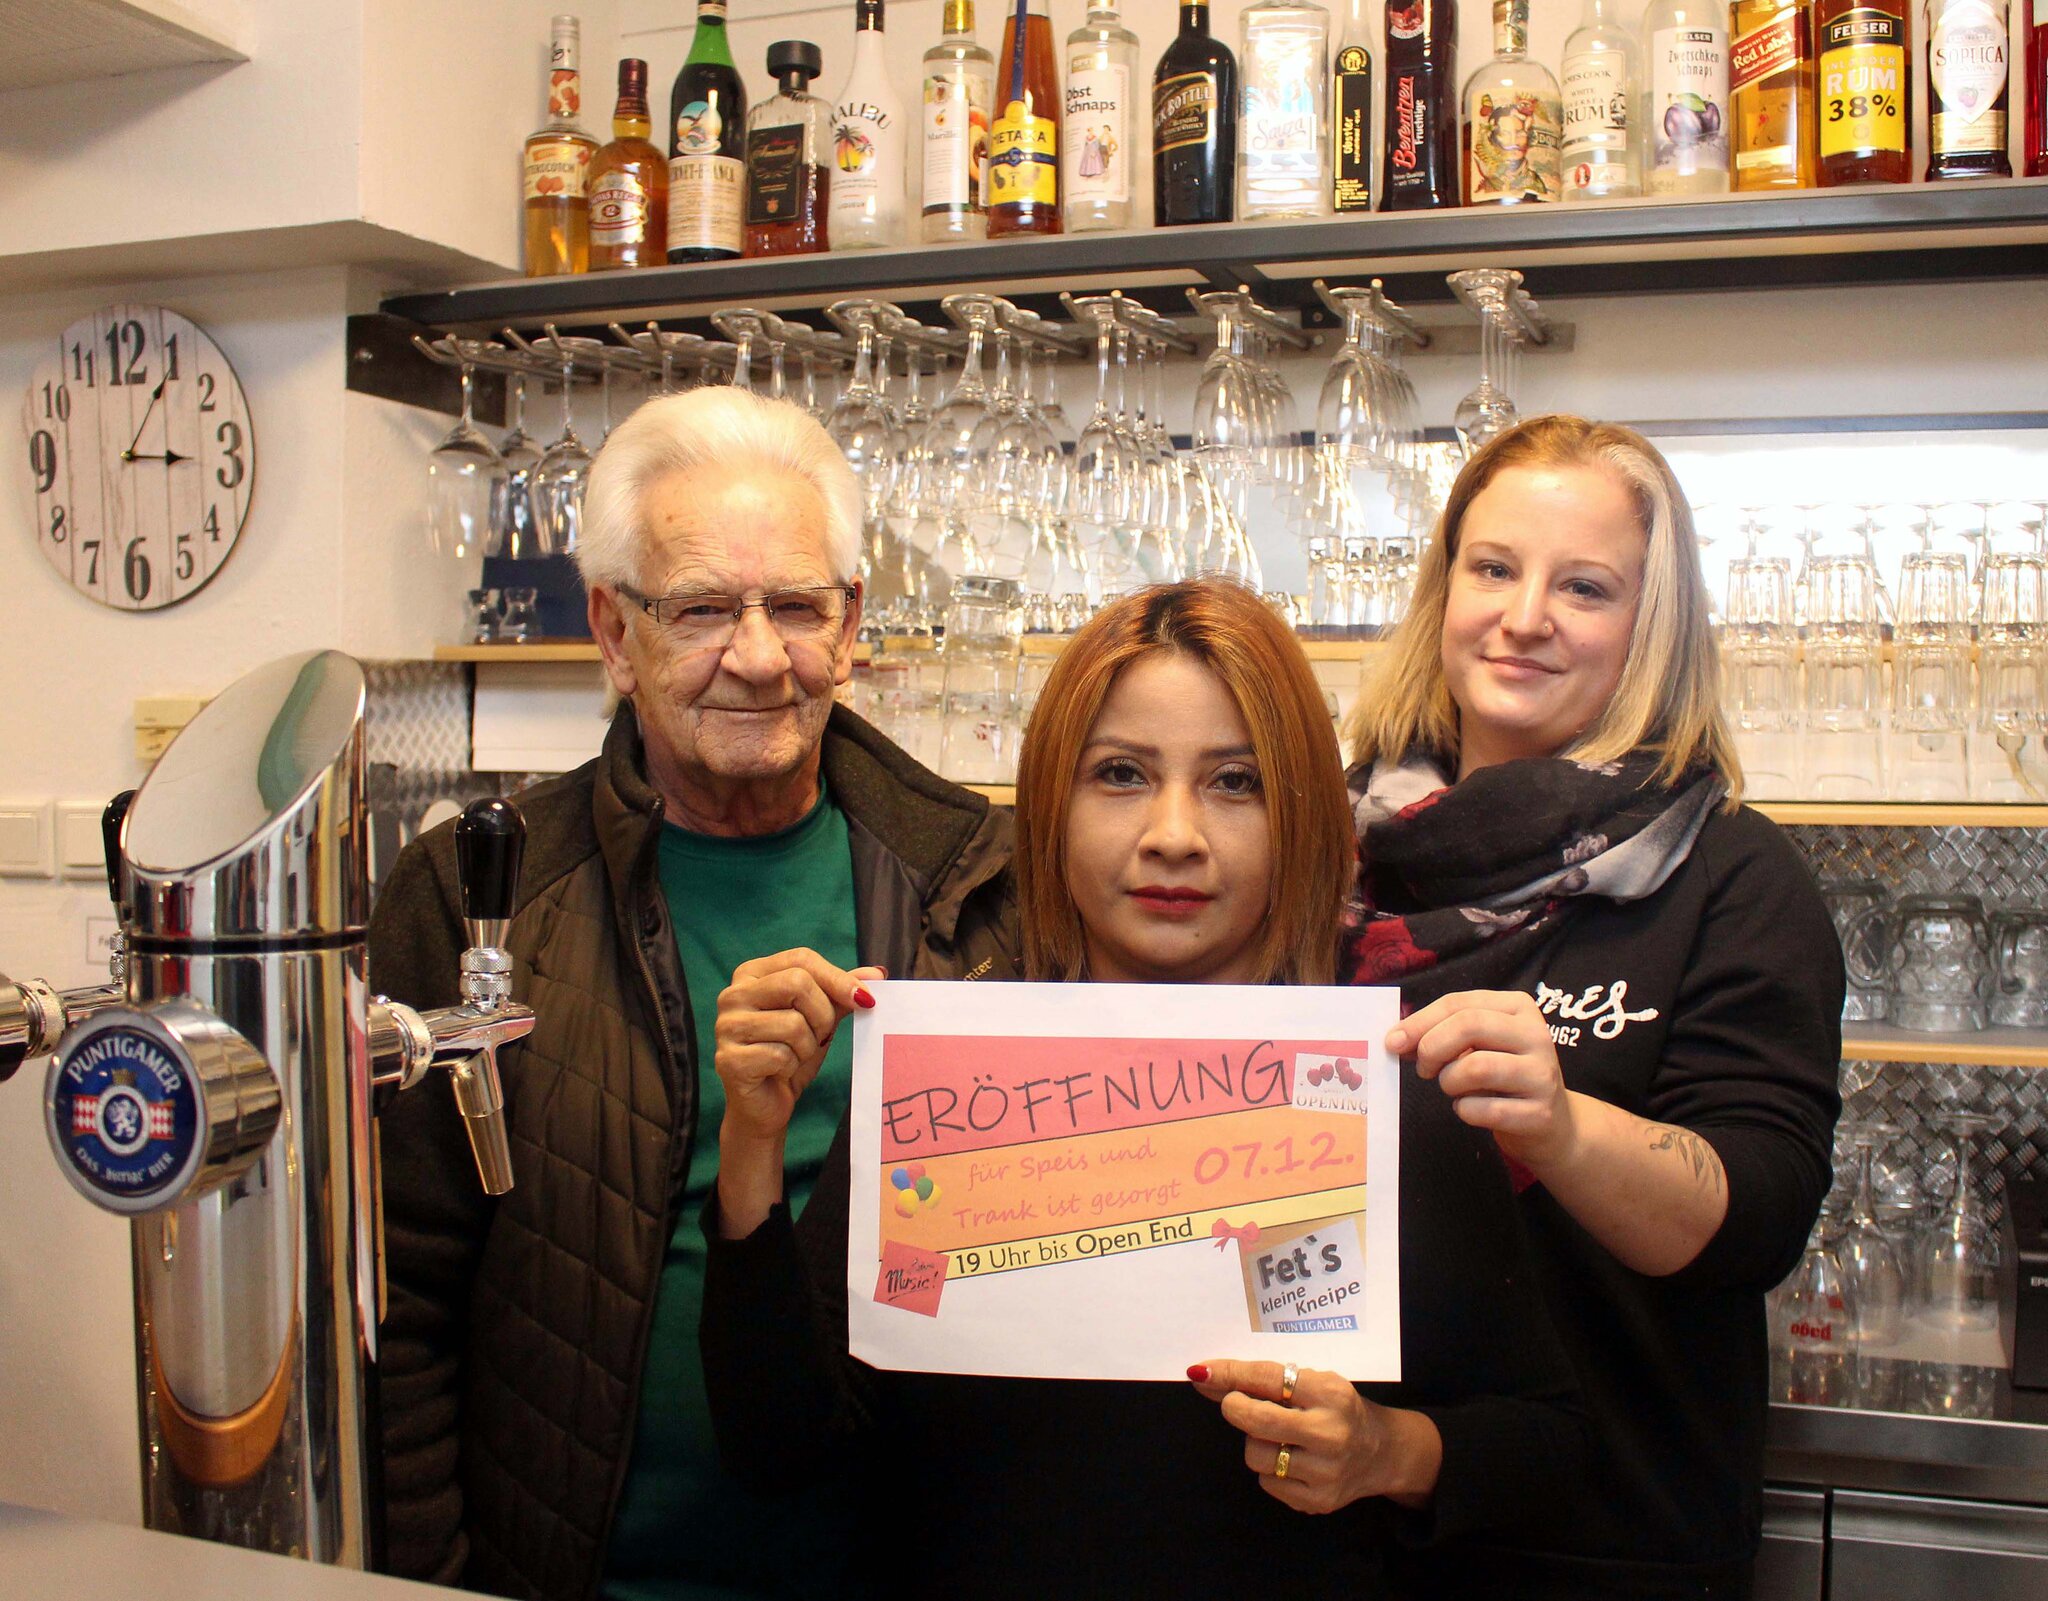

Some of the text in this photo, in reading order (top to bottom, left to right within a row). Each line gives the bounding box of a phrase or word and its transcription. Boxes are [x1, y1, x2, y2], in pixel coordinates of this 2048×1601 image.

[1733, 30, 1796, 70] Red Label
[1833, 22, 1889, 39] FELSER
[1826, 66, 1897, 97] RUM
[1392, 76, 1416, 169] Berentzen
[1566, 105, 1604, 125] RUM
[1828, 94, 1896, 122] 38%
[71, 341, 95, 388] 11
[105, 320, 148, 386] 12
[165, 333, 179, 380] 1
[42, 380, 71, 422] 10
[199, 373, 215, 412] 2
[29, 429, 57, 494] 9
[216, 421, 244, 488] 3
[51, 505, 67, 543] 8
[203, 504, 220, 541] 4
[82, 541, 101, 584] 7
[123, 536, 151, 601] 6
[175, 534, 194, 579] 5
[1547, 1023, 1581, 1047] 462
[66, 1037, 182, 1094] PUNTIGAMER
[882, 1040, 1291, 1145] ERÖFFNUNG
[967, 1137, 1158, 1192] für Speis und
[1194, 1131, 1355, 1185] 07.12.
[953, 1178, 1184, 1230] Trank ist gesorgt
[955, 1216, 1193, 1275] 19 Uhr bis Open End
[884, 1268, 939, 1294] Music!
[1260, 1286, 1307, 1315] kleine
[1295, 1280, 1361, 1316] Kneipe
[1276, 1316, 1353, 1333] PUNTIGAMER
